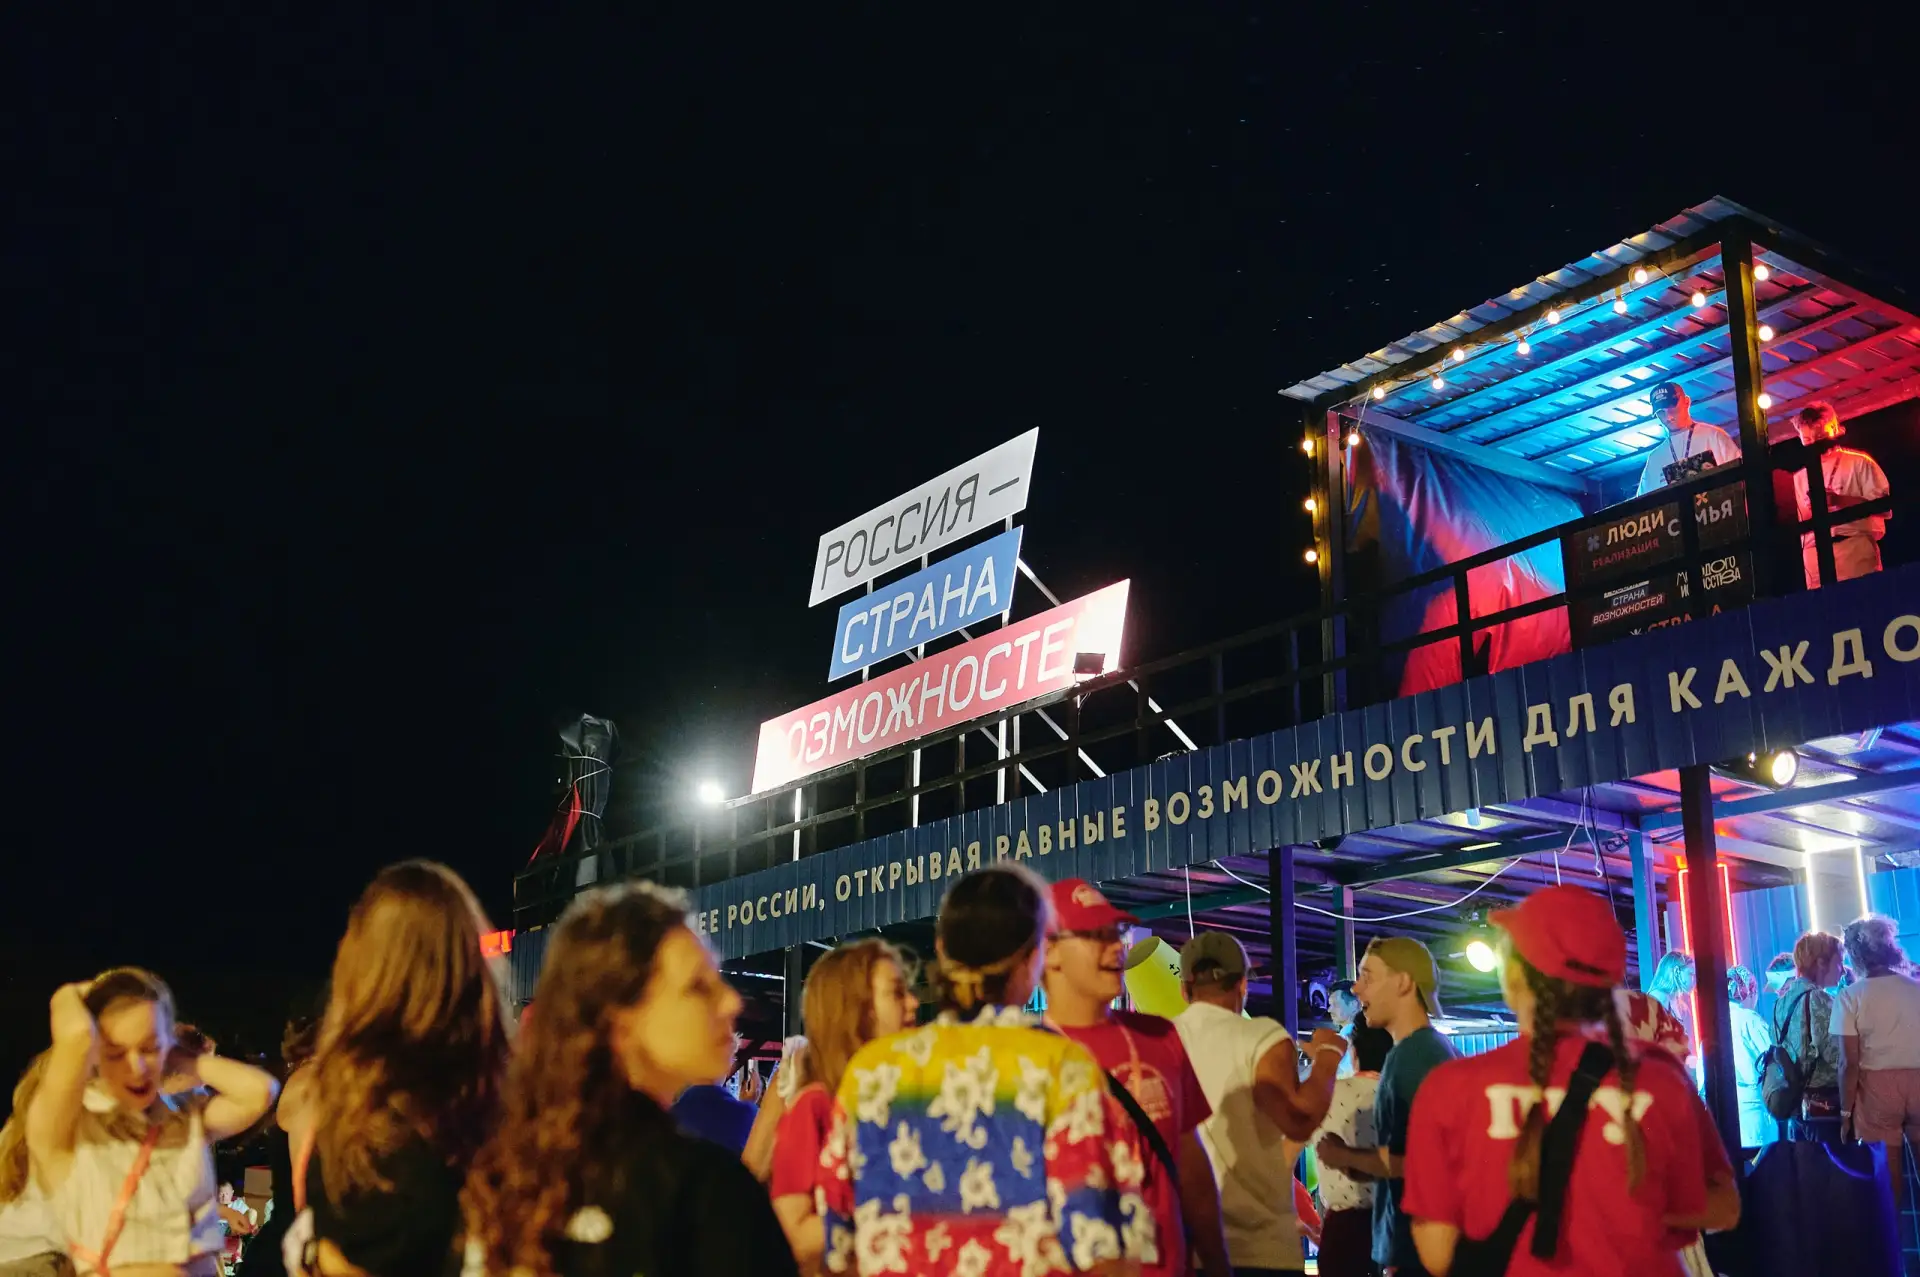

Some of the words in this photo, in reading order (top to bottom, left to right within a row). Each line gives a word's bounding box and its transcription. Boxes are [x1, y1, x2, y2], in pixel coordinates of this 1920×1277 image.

[820, 473, 980, 591] РОССИЯ
[1606, 510, 1664, 546] ЛЮДИ
[1667, 499, 1733, 537] СМЬЯ
[1593, 538, 1660, 569] РЕАЛИЗАЦИЯ
[840, 556, 998, 665] СТРАНА
[1593, 593, 1664, 624] ВОЗМОЖНОСТЕЙ
[1612, 588, 1646, 606] СТРАНА
[784, 614, 1080, 768] ОЗМОЖНОСТЕ
[727, 882, 826, 929] РОССИИ,
[835, 840, 981, 902] ОТКРЫВАЯ
[996, 805, 1127, 862] РАВНЫЕ
[1144, 716, 1497, 832] ВОЗМОЖНОСТИ
[1522, 682, 1637, 753] ДЛЯ
[1667, 613, 1920, 713] КАЖДО
